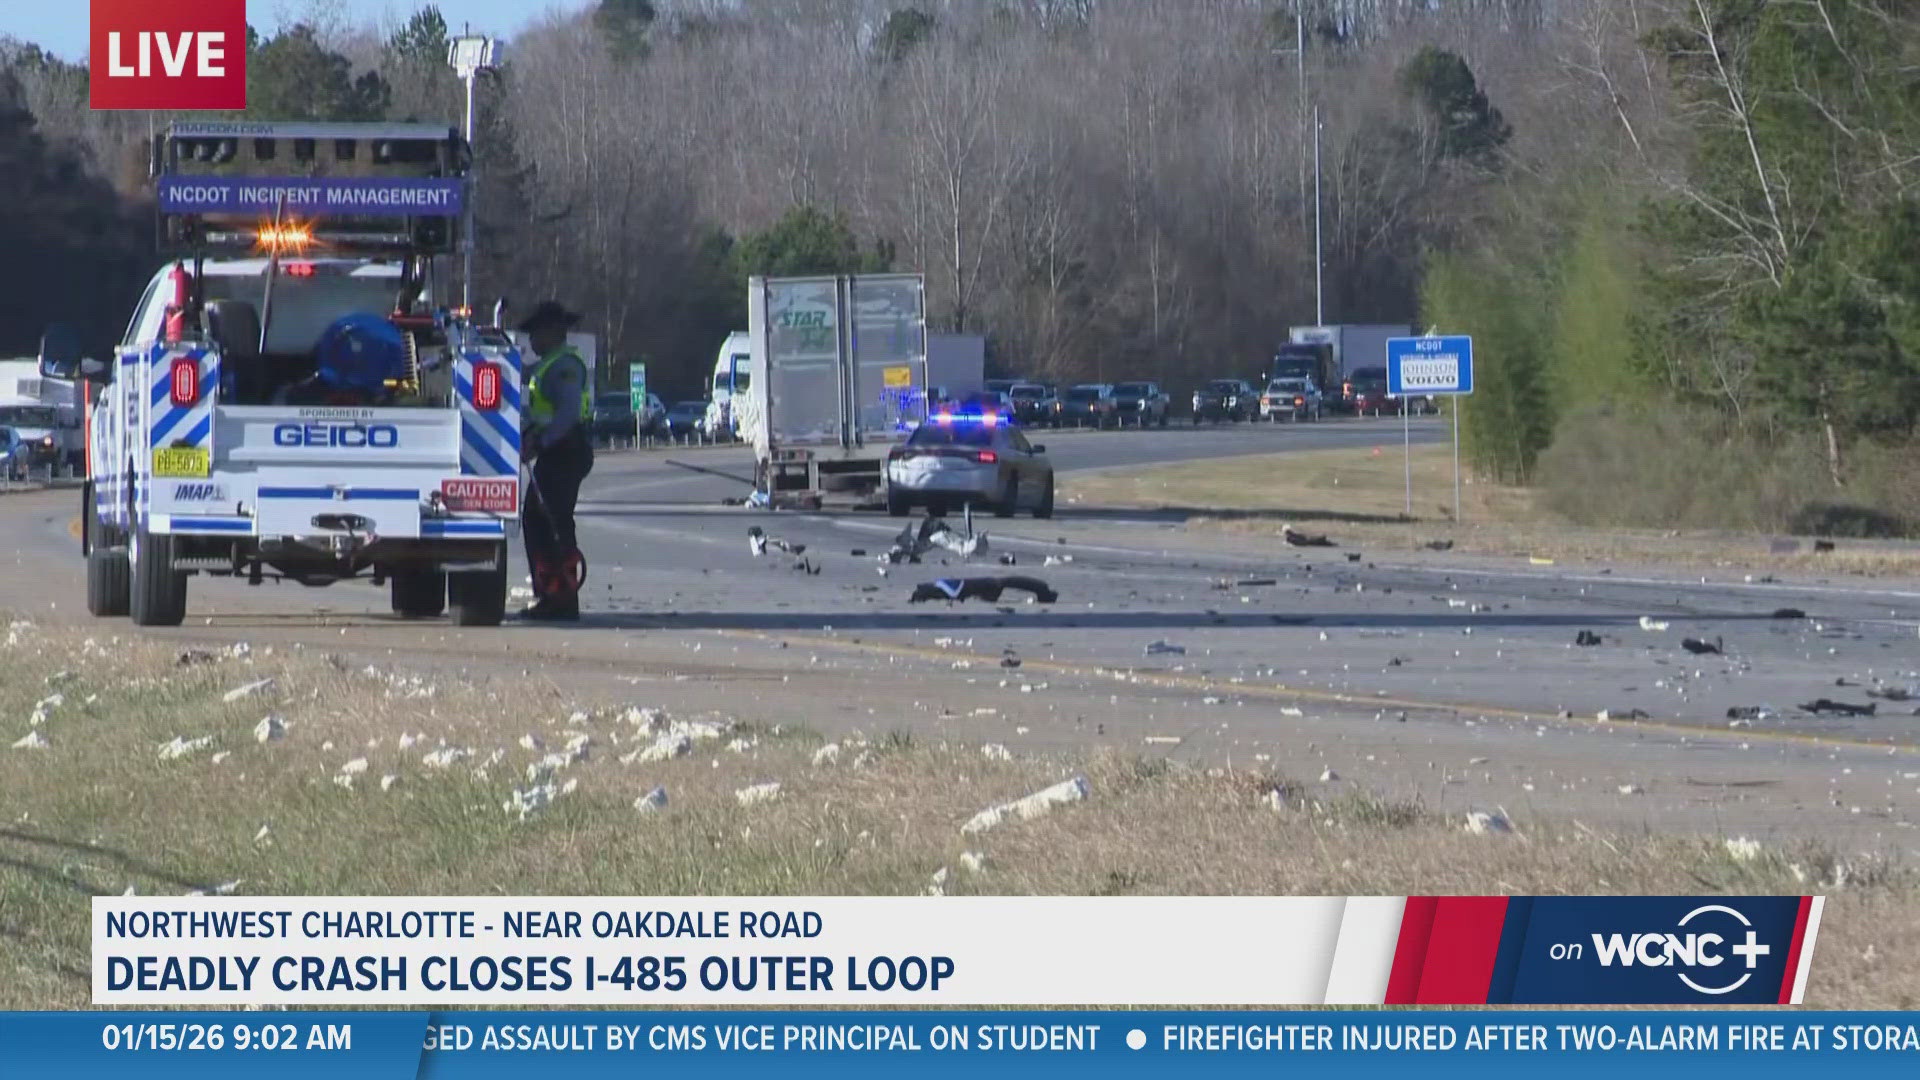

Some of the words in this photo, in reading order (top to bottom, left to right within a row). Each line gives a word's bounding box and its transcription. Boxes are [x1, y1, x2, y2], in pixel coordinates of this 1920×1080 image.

[169, 187, 230, 203] NCDOT
[238, 187, 320, 204] INCIDENT
[326, 188, 449, 206] MANAGEMENT
[782, 310, 827, 327] STAR
[1415, 341, 1443, 351] NCDOT
[1403, 362, 1456, 375] JOHNSON
[1405, 376, 1456, 385] VOLVO
[299, 408, 359, 417] SPONSORED
[361, 408, 375, 417] BY
[273, 423, 398, 447] GEICO
[174, 484, 214, 501] IMAP
[446, 482, 513, 498] CAUTION
